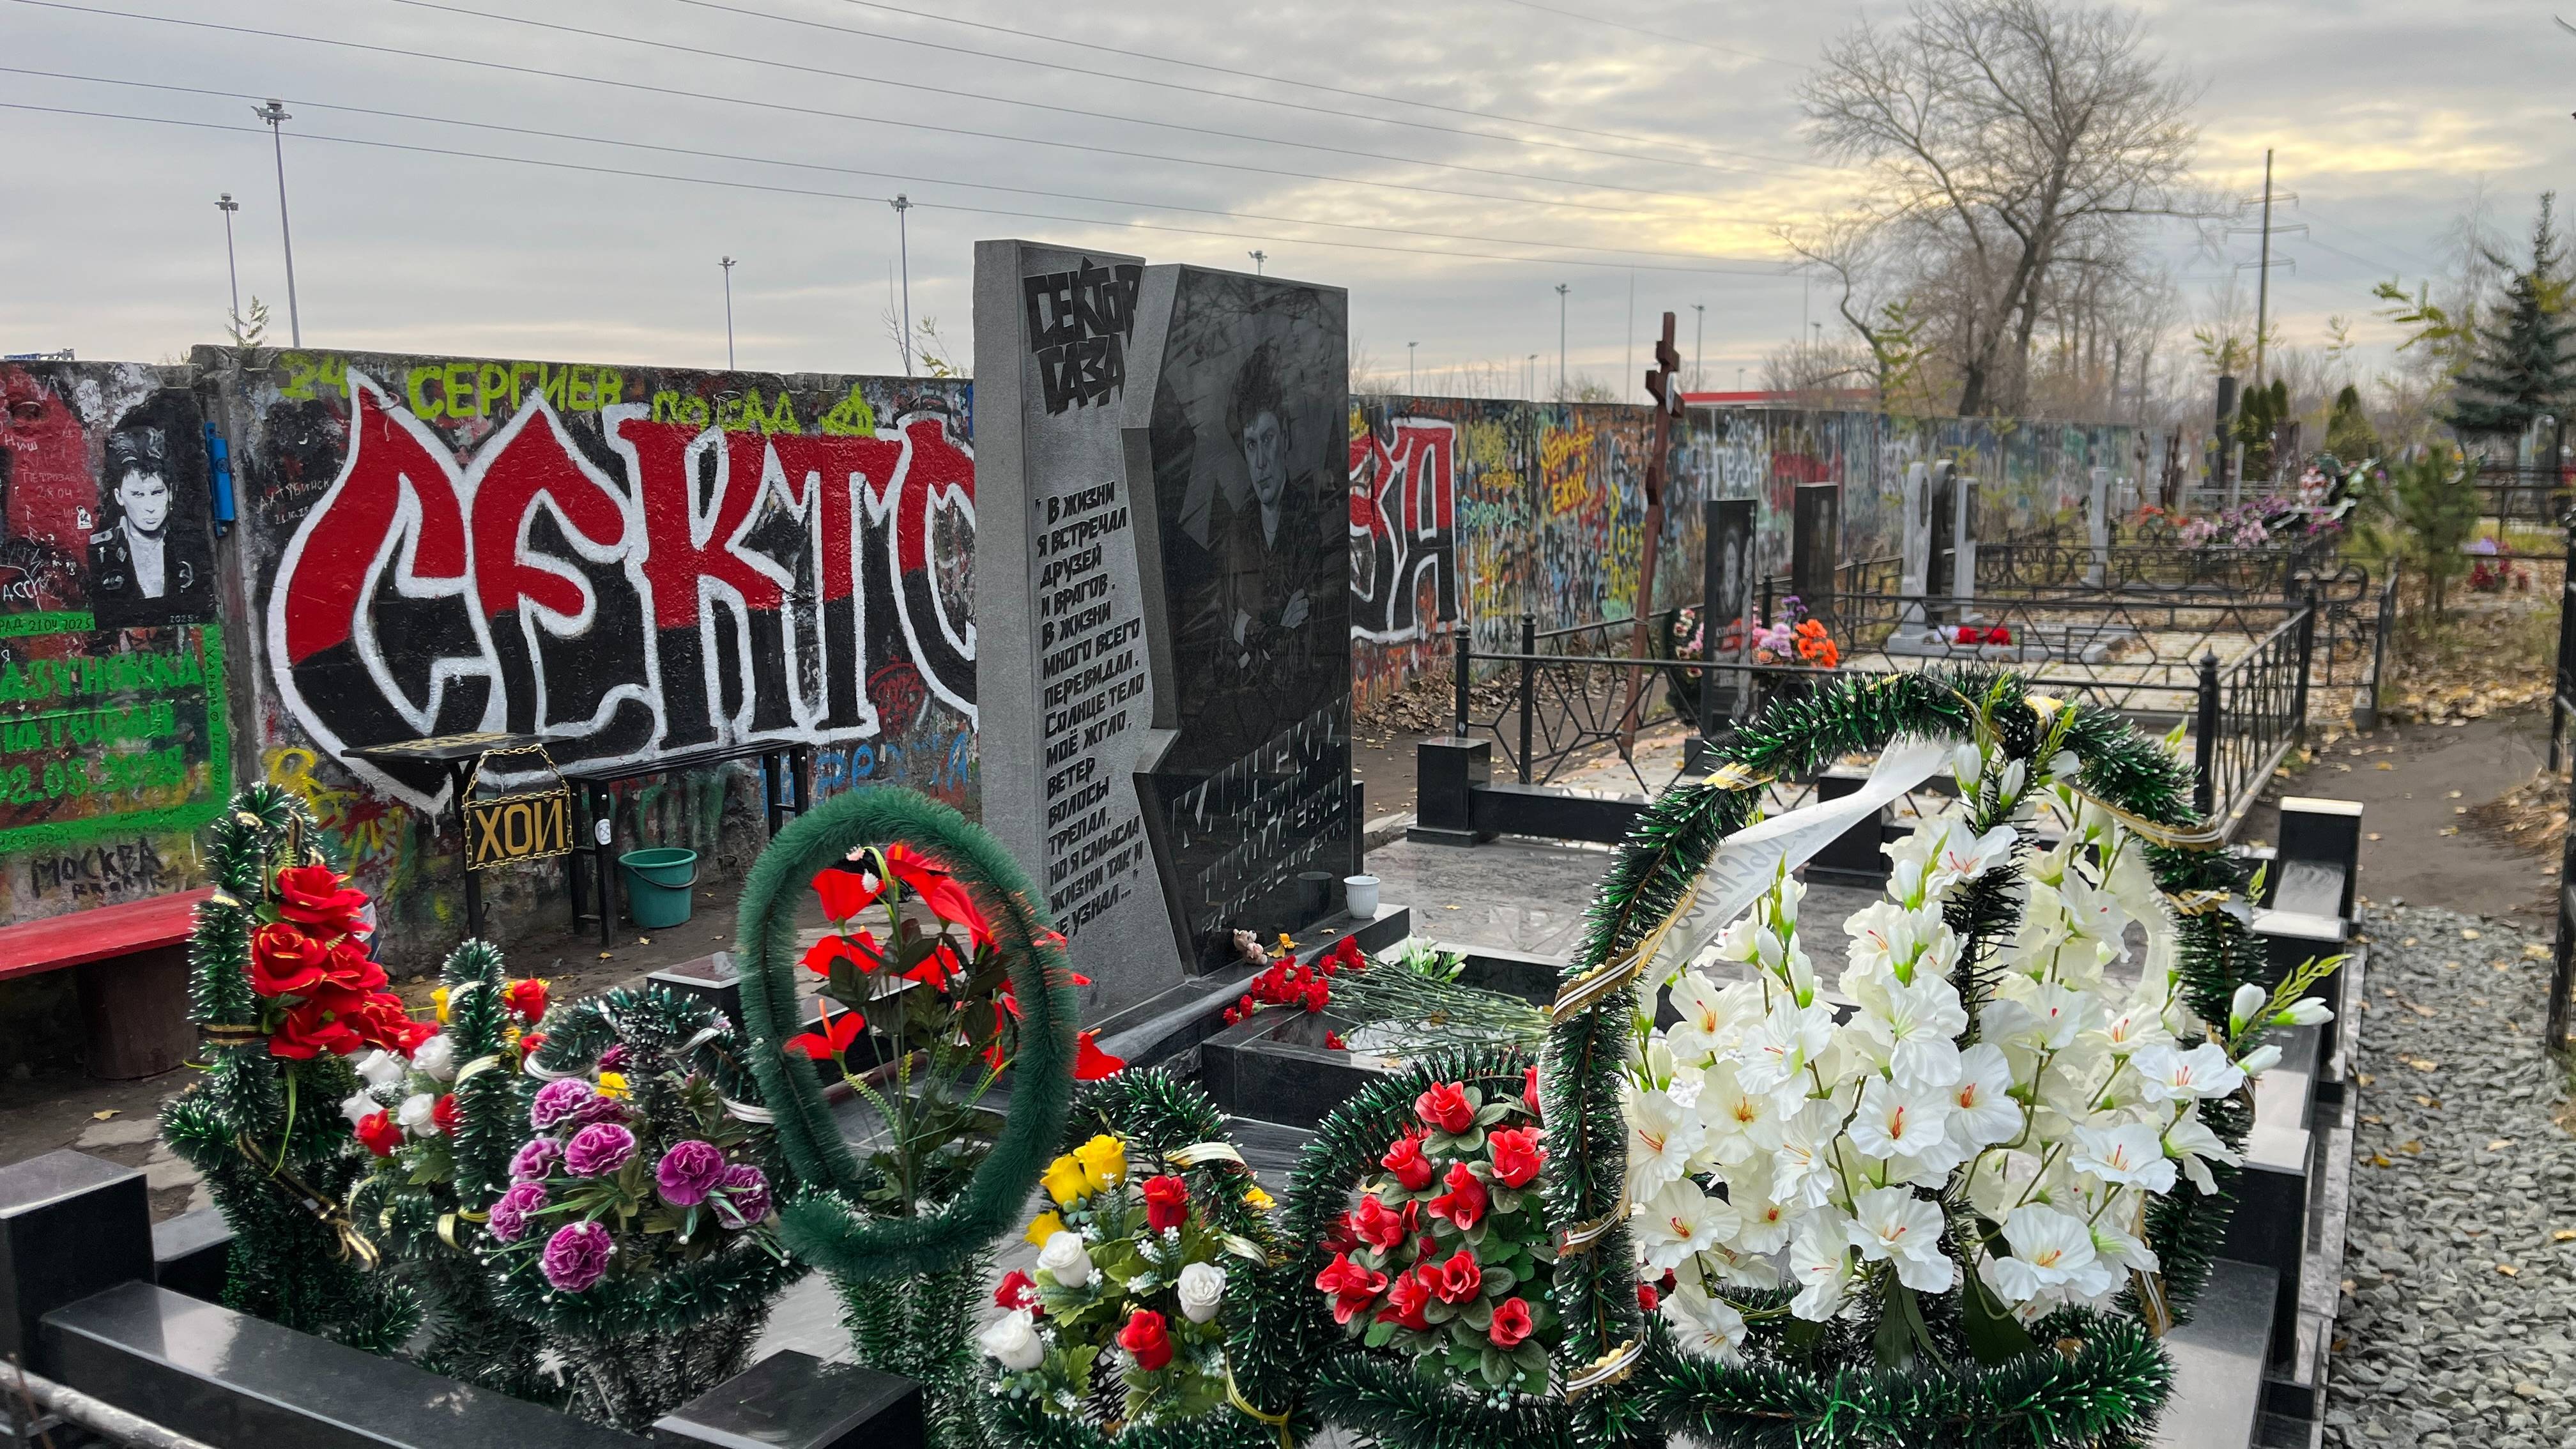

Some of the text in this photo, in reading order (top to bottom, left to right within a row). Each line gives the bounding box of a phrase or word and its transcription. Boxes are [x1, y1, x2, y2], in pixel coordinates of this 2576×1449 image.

[1023, 256, 1146, 352] СЕКТОР
[407, 362, 624, 420] СЕРГИЕВ
[1038, 334, 1125, 417] ГАЗА
[1062, 482, 1115, 518] ЖИЗНИ
[1038, 507, 1126, 557] Я ВСТРЕЧАЛ
[1040, 542, 1101, 589] ДРУЗЕЙ
[1041, 595, 1050, 620] И
[1043, 601, 1110, 651] В ЖИЗНИ
[1043, 617, 1140, 680] МНОГО ВСЕГО
[1045, 672, 1144, 739] СОЛНЦЕ ТЕЛО
[1046, 728, 1078, 768] МОЁ
[1047, 756, 1095, 801] ВЕТЕР
[1048, 776, 1109, 829] ВОЛОСЫ
[475, 798, 564, 862] ХОЙ
[1048, 806, 1111, 855] ТРЕПАЛ,
[1050, 815, 1140, 886] НО Я СМЫСЛА
[1050, 840, 1143, 914] ЖИЗНИ ТАК И
